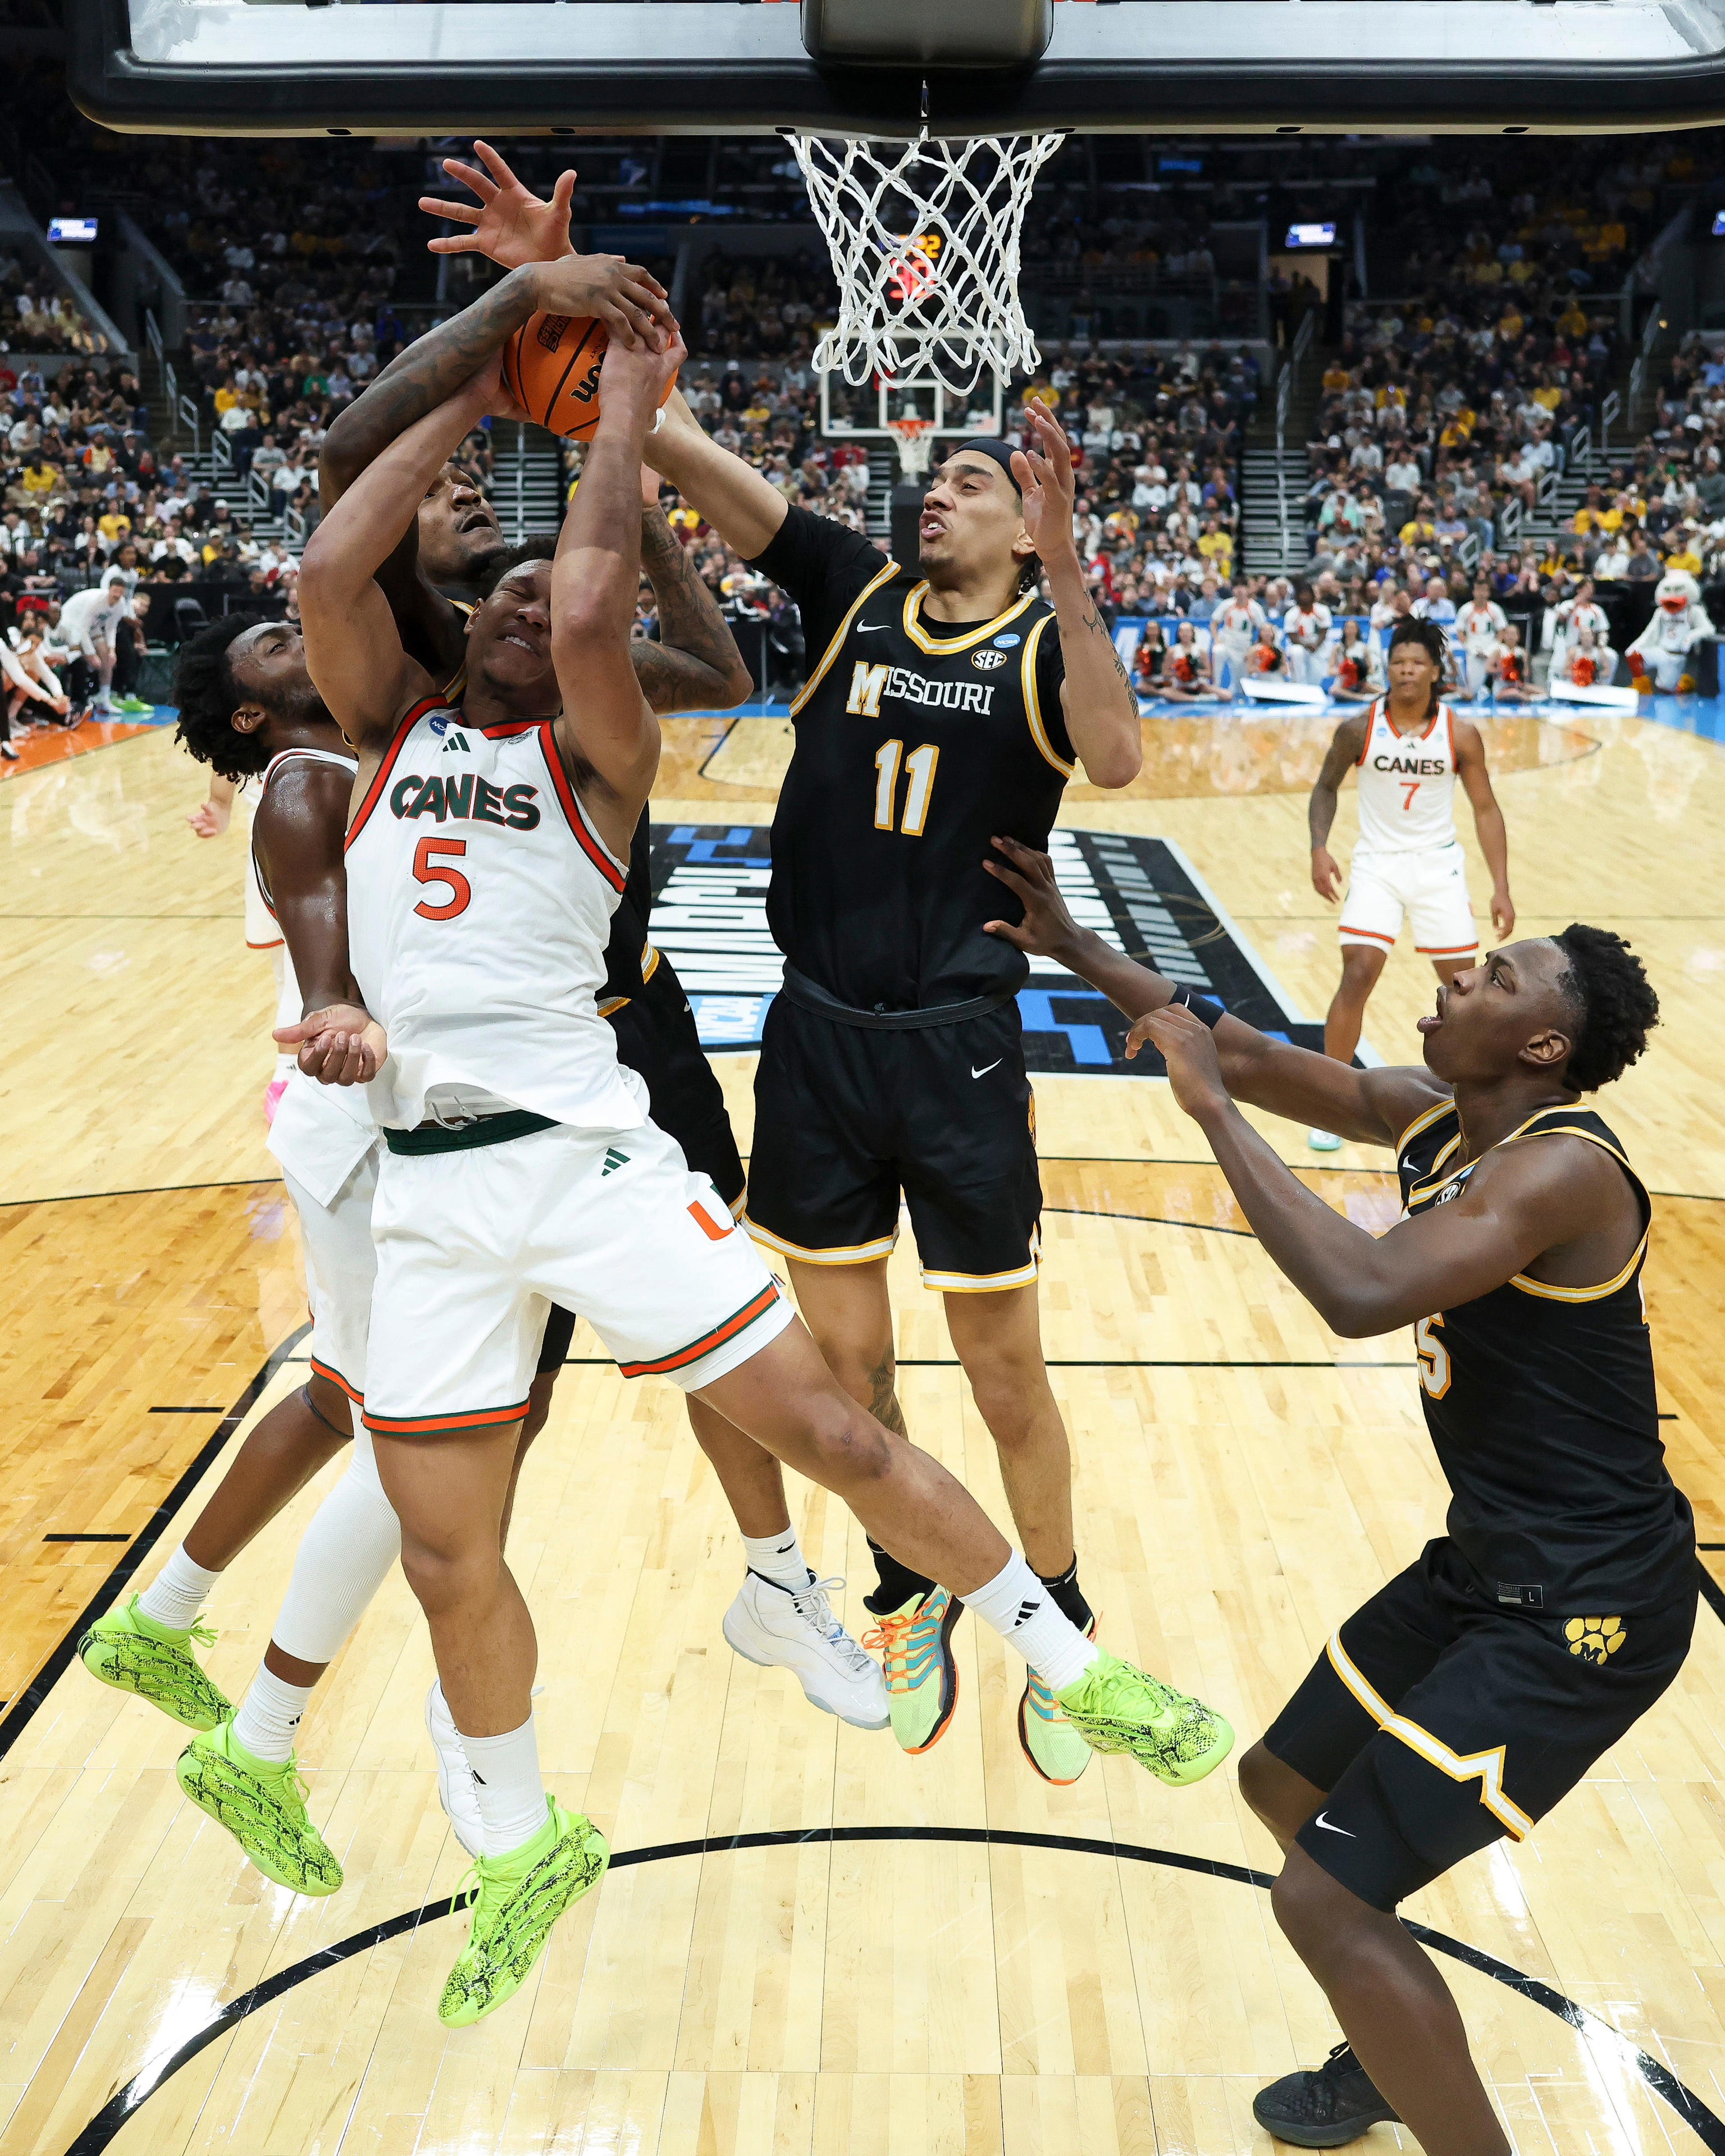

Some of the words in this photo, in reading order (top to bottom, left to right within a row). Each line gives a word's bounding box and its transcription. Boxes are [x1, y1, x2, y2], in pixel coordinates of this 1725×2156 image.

[846, 660, 995, 718] MISSOURI
[974, 651, 1004, 669] SEC
[874, 738, 940, 837] 11
[1374, 755, 1445, 775] CANES
[390, 773, 541, 831] CANES
[1399, 781, 1421, 811] 7
[412, 836, 472, 921] 5
[1416, 1312, 1452, 1400] 5
[1528, 1591, 1535, 1602] L
